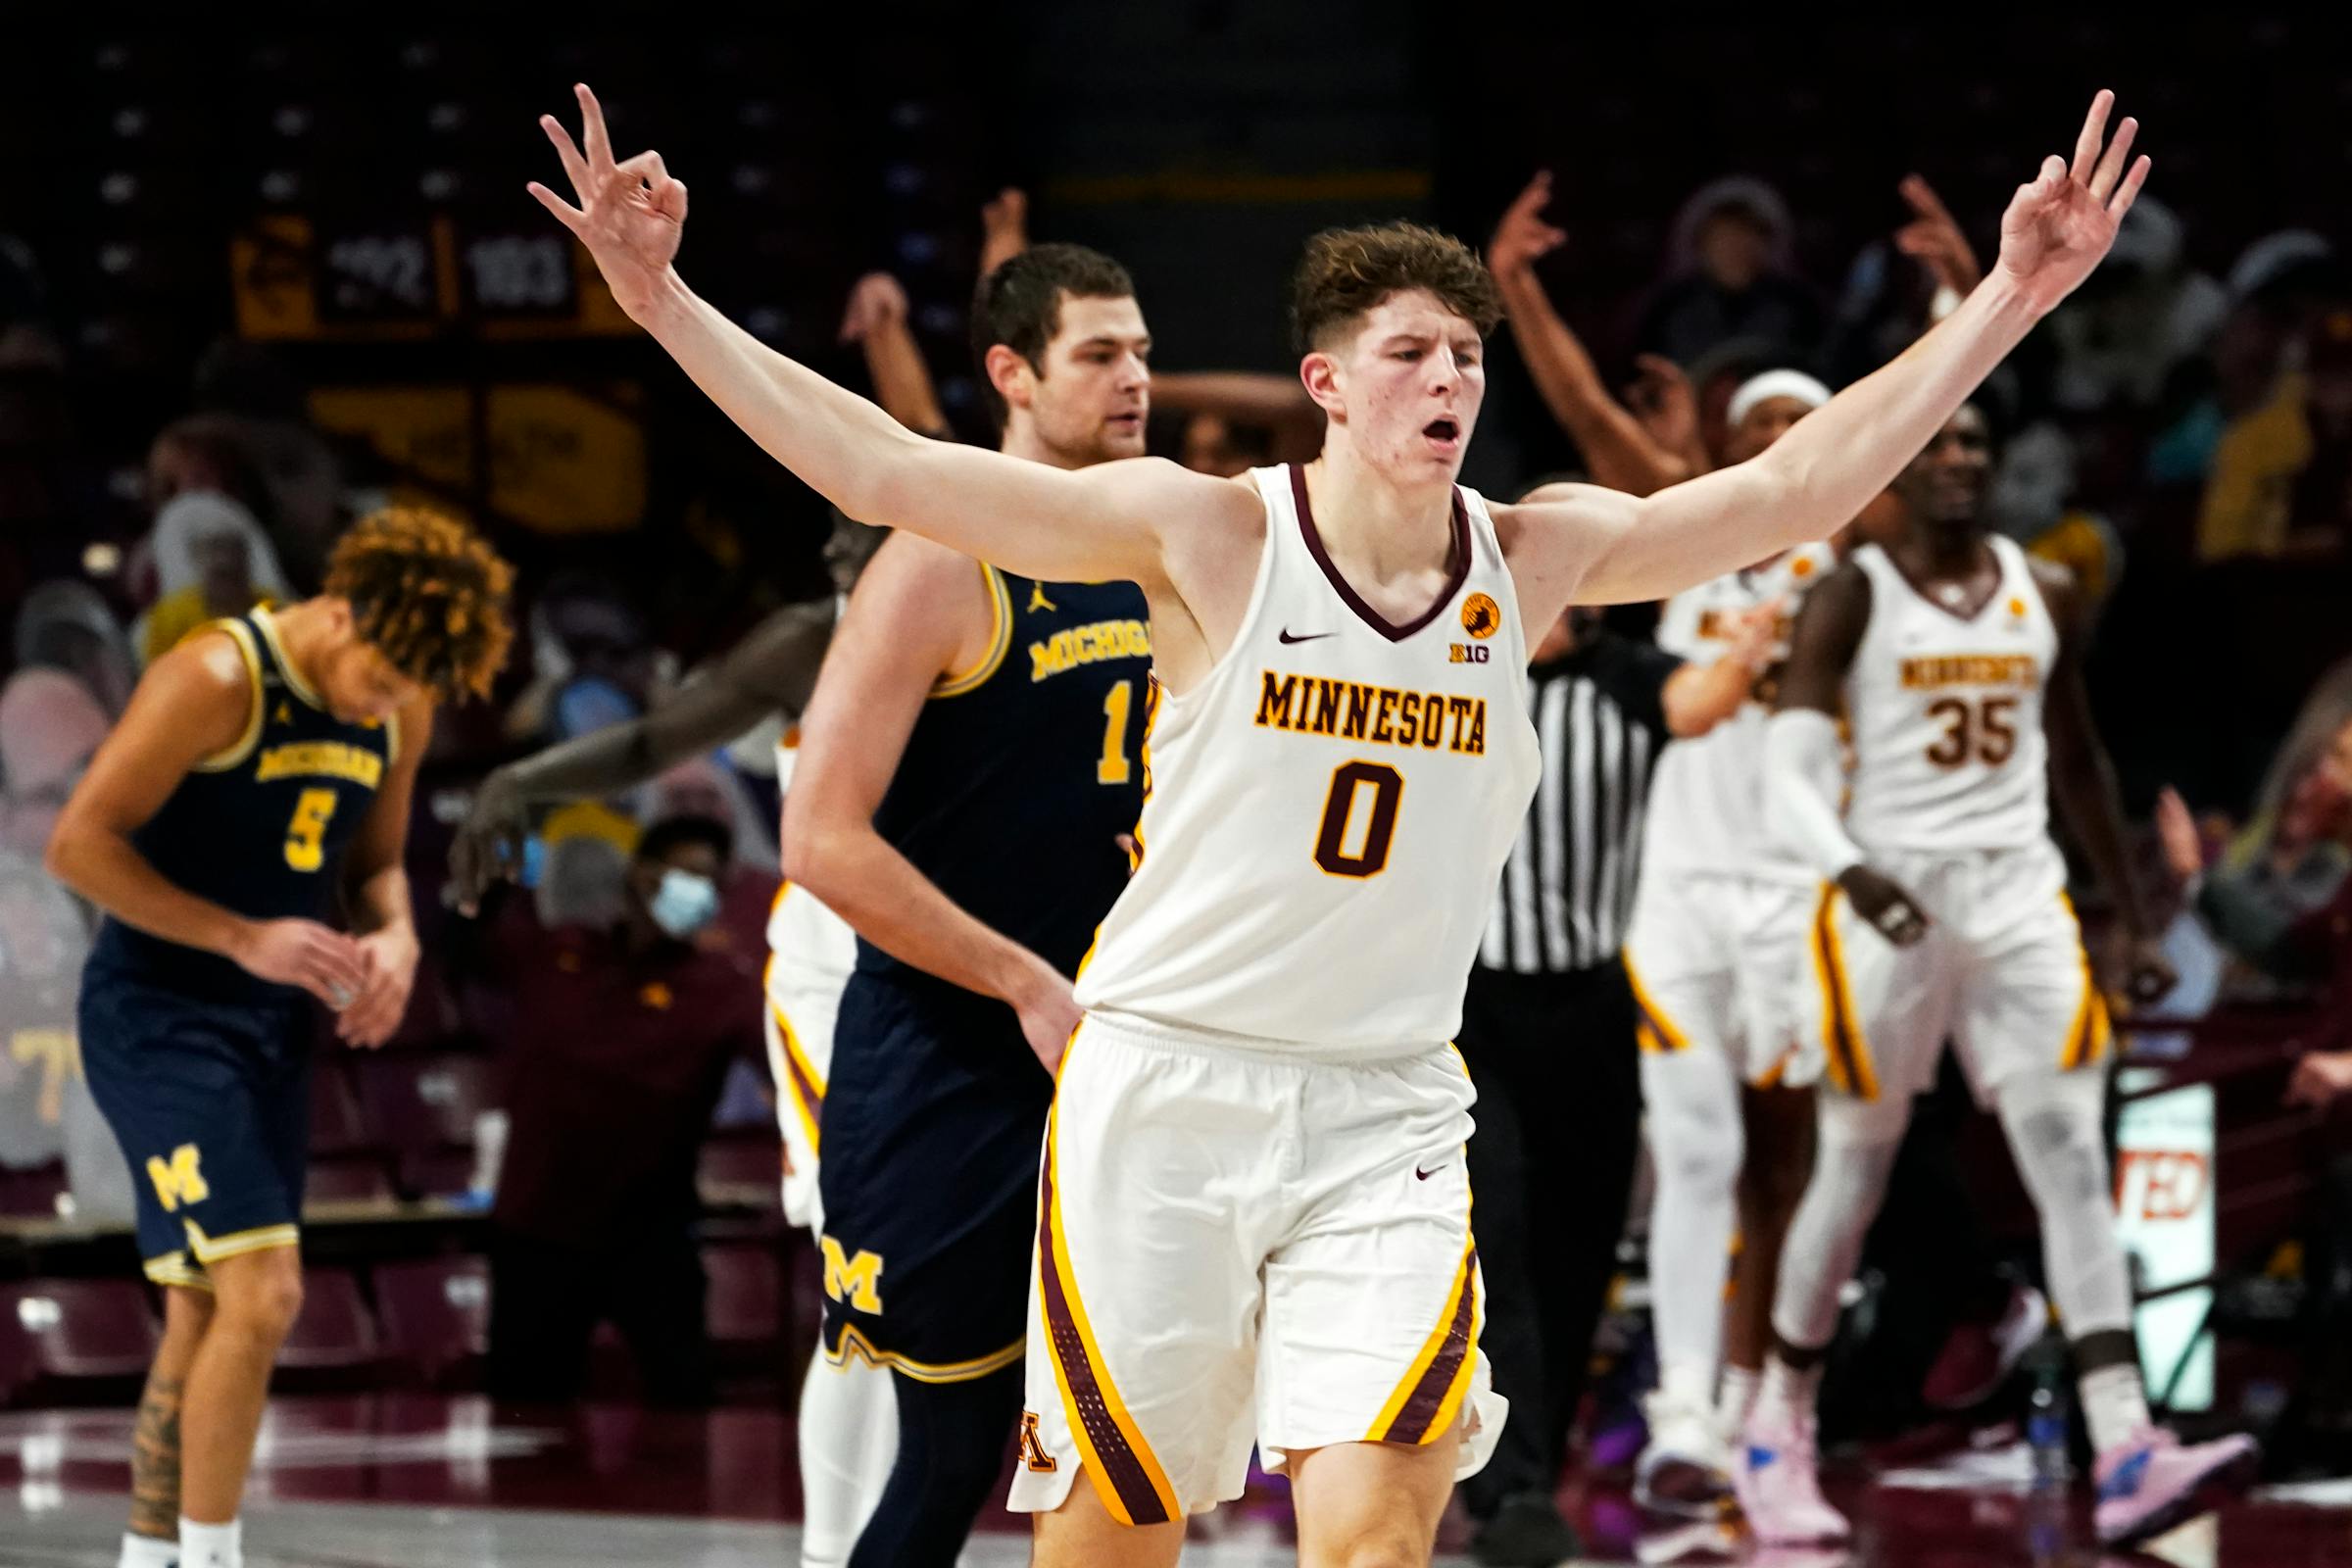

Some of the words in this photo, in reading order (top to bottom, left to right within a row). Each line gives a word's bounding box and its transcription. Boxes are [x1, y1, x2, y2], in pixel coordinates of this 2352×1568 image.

[1029, 619, 1152, 683] MICHIG
[1098, 680, 1133, 785] 1
[1254, 668, 1488, 757] MINNESOTA
[1923, 696, 2020, 772] 35
[282, 787, 339, 874] 5
[1312, 759, 1406, 878] 0
[146, 1142, 211, 1214] M
[819, 1233, 885, 1317] M
